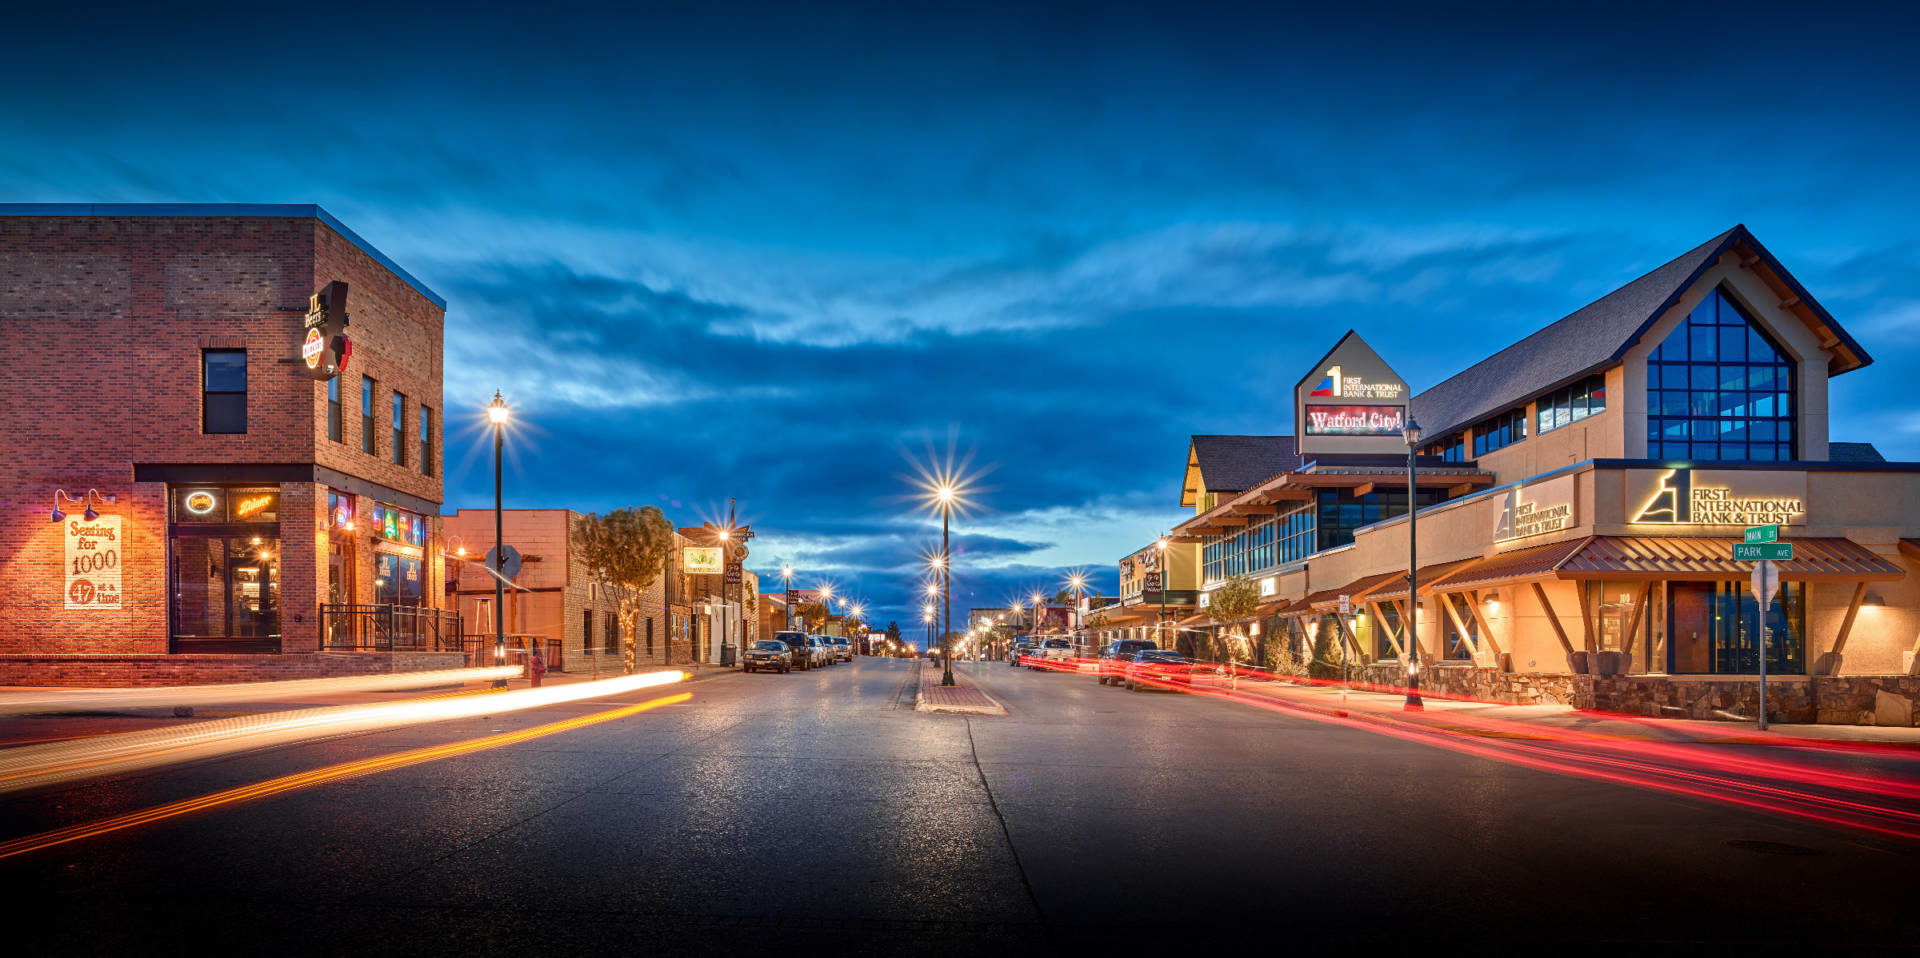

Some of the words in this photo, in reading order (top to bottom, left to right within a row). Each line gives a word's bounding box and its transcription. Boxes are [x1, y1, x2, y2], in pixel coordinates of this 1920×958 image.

[310, 293, 320, 313] JL
[305, 311, 321, 328] Beers
[1310, 411, 1367, 428] Watford
[1370, 411, 1401, 431] City!
[1693, 489, 1729, 500] FIRST
[1693, 501, 1804, 513] INTERNATIONAL
[1693, 512, 1731, 524] BANK
[1734, 513, 1746, 524] &
[1749, 512, 1793, 524] TRUST
[70, 521, 115, 541] Seating
[1747, 530, 1762, 541] MAIN
[77, 537, 97, 550] for
[1738, 547, 1762, 557] PARK
[1777, 549, 1789, 557] AVE
[73, 550, 116, 576] 1000
[73, 584, 92, 602] 47
[97, 583, 107, 592] at
[97, 592, 119, 603] time
